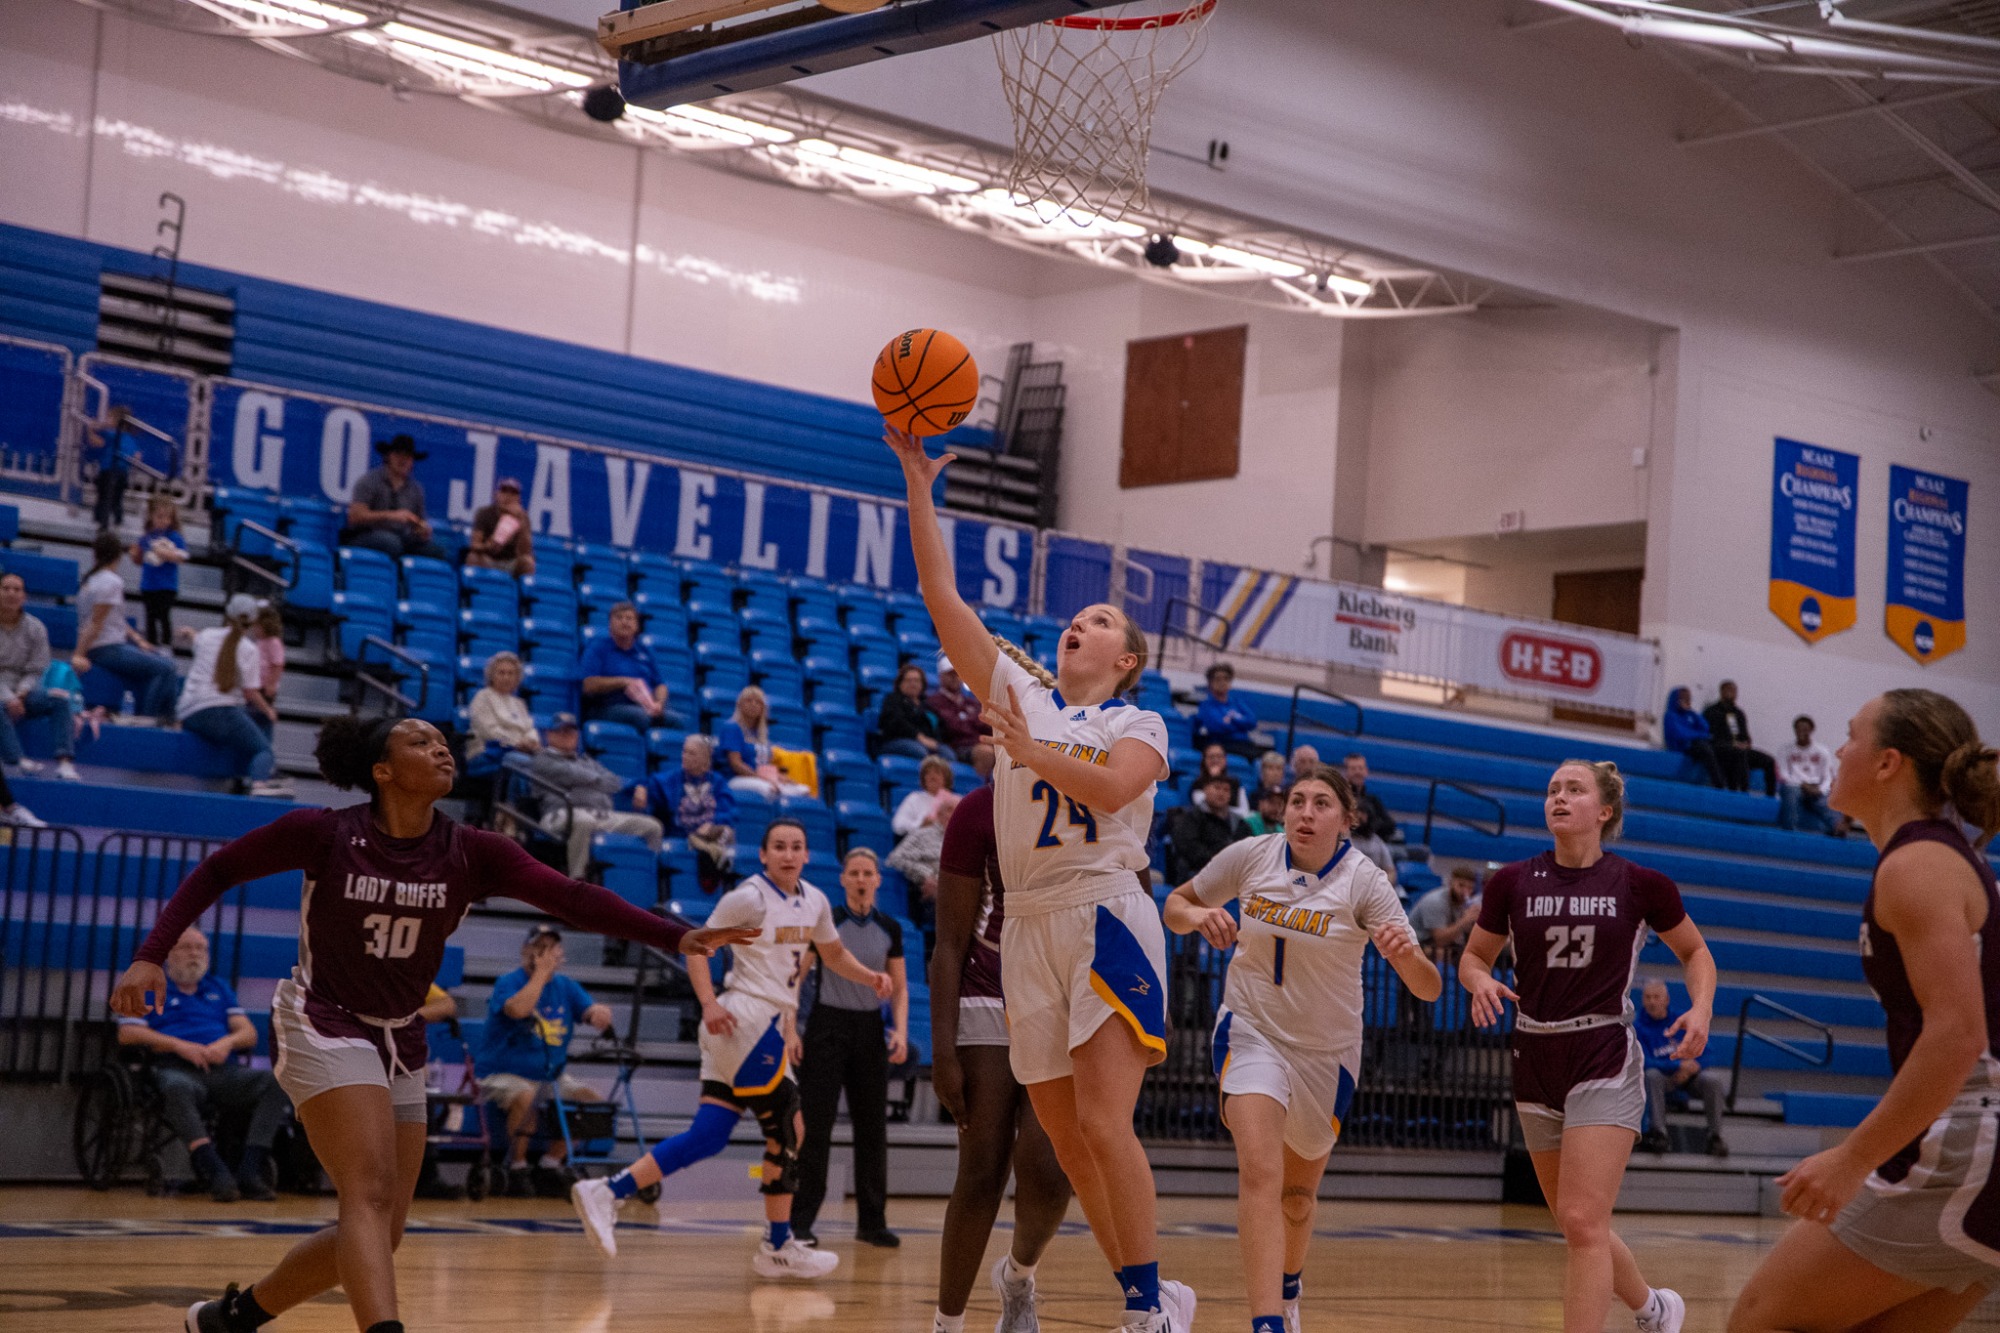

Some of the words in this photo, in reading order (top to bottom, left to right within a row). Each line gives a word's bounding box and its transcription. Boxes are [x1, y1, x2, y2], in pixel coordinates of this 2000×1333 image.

[231, 391, 371, 502] GO
[1338, 591, 1415, 631] Kleberg
[1350, 627, 1398, 656] Bank
[1032, 779, 1099, 849] 24
[344, 873, 392, 903] LADY
[395, 881, 447, 908] BUFFS
[1526, 896, 1565, 918] LADY
[1569, 896, 1617, 918] BUFFS
[363, 913, 423, 959] 30
[1545, 925, 1596, 968] 23
[1272, 934, 1286, 986] 1
